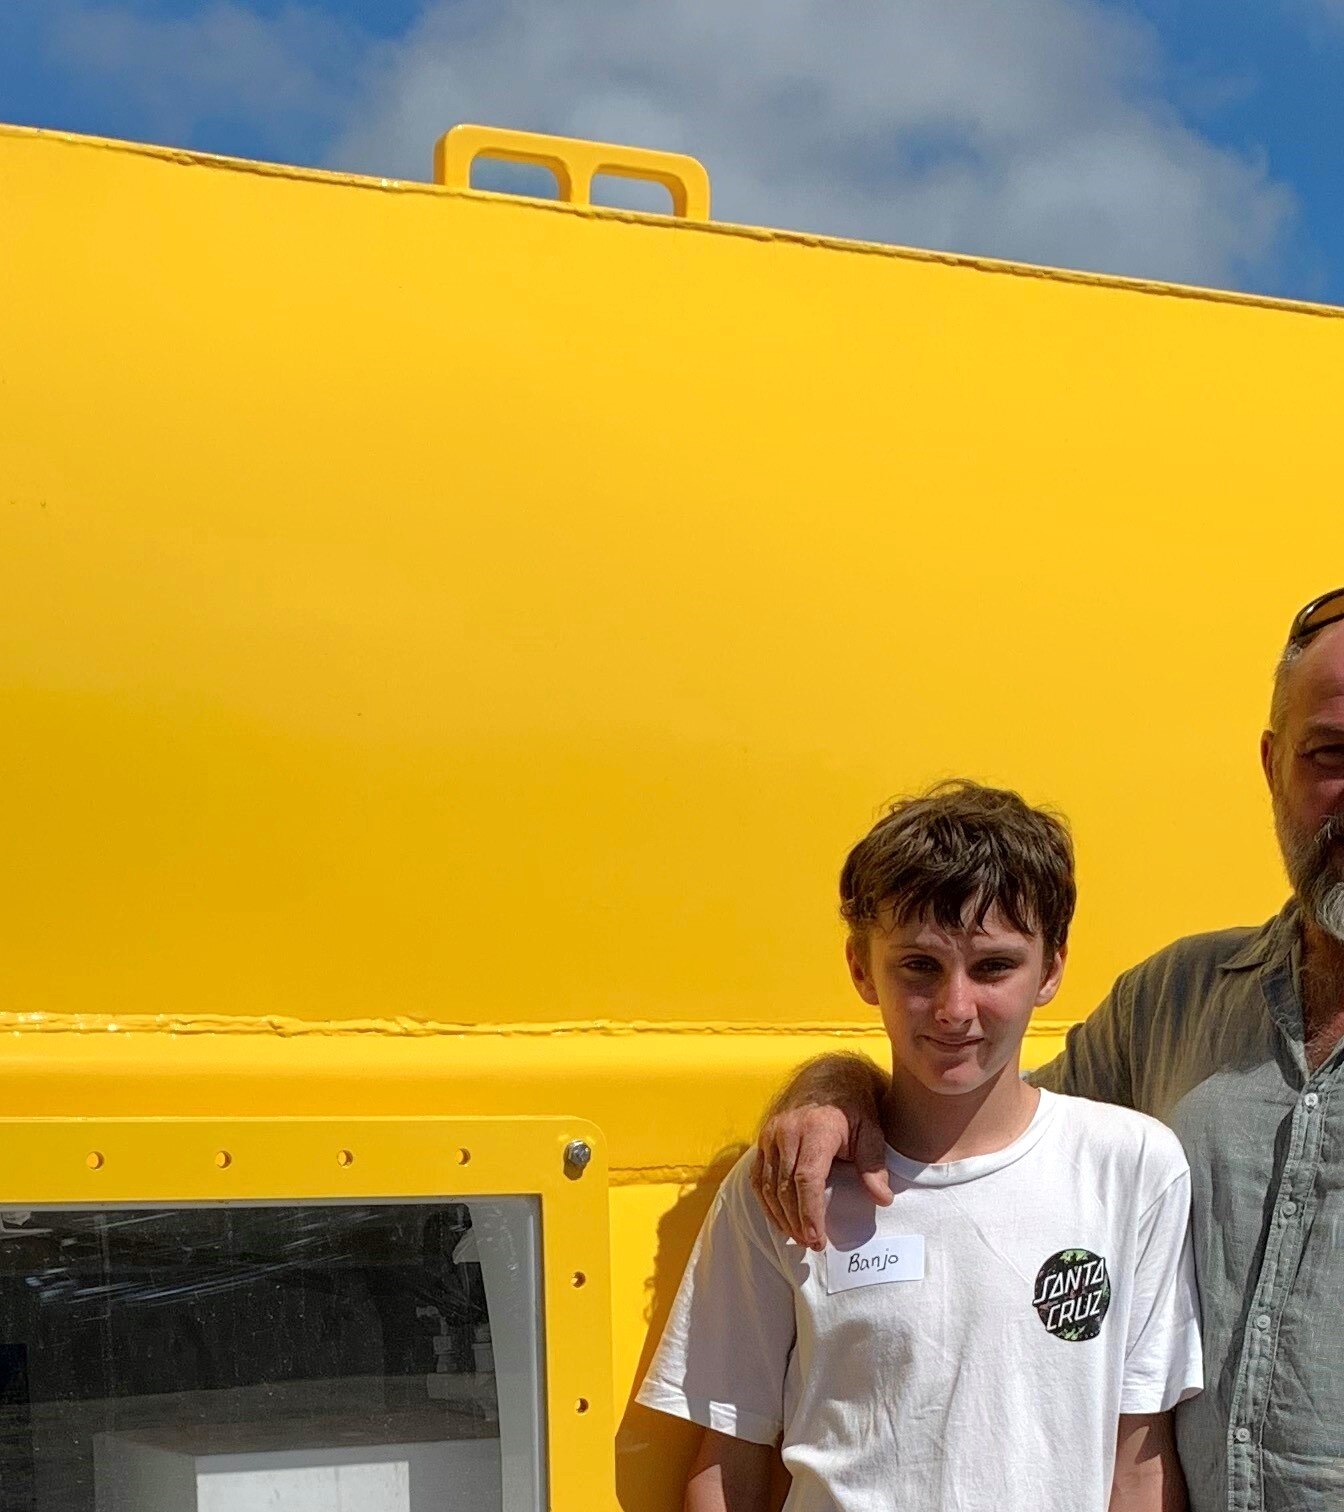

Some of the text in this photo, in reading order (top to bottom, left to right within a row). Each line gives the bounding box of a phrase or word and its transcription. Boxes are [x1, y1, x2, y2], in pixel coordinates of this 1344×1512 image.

[847, 1247, 899, 1273] Banjo
[1033, 1258, 1105, 1304] SANTA
[1046, 1289, 1103, 1331] CRUZ
